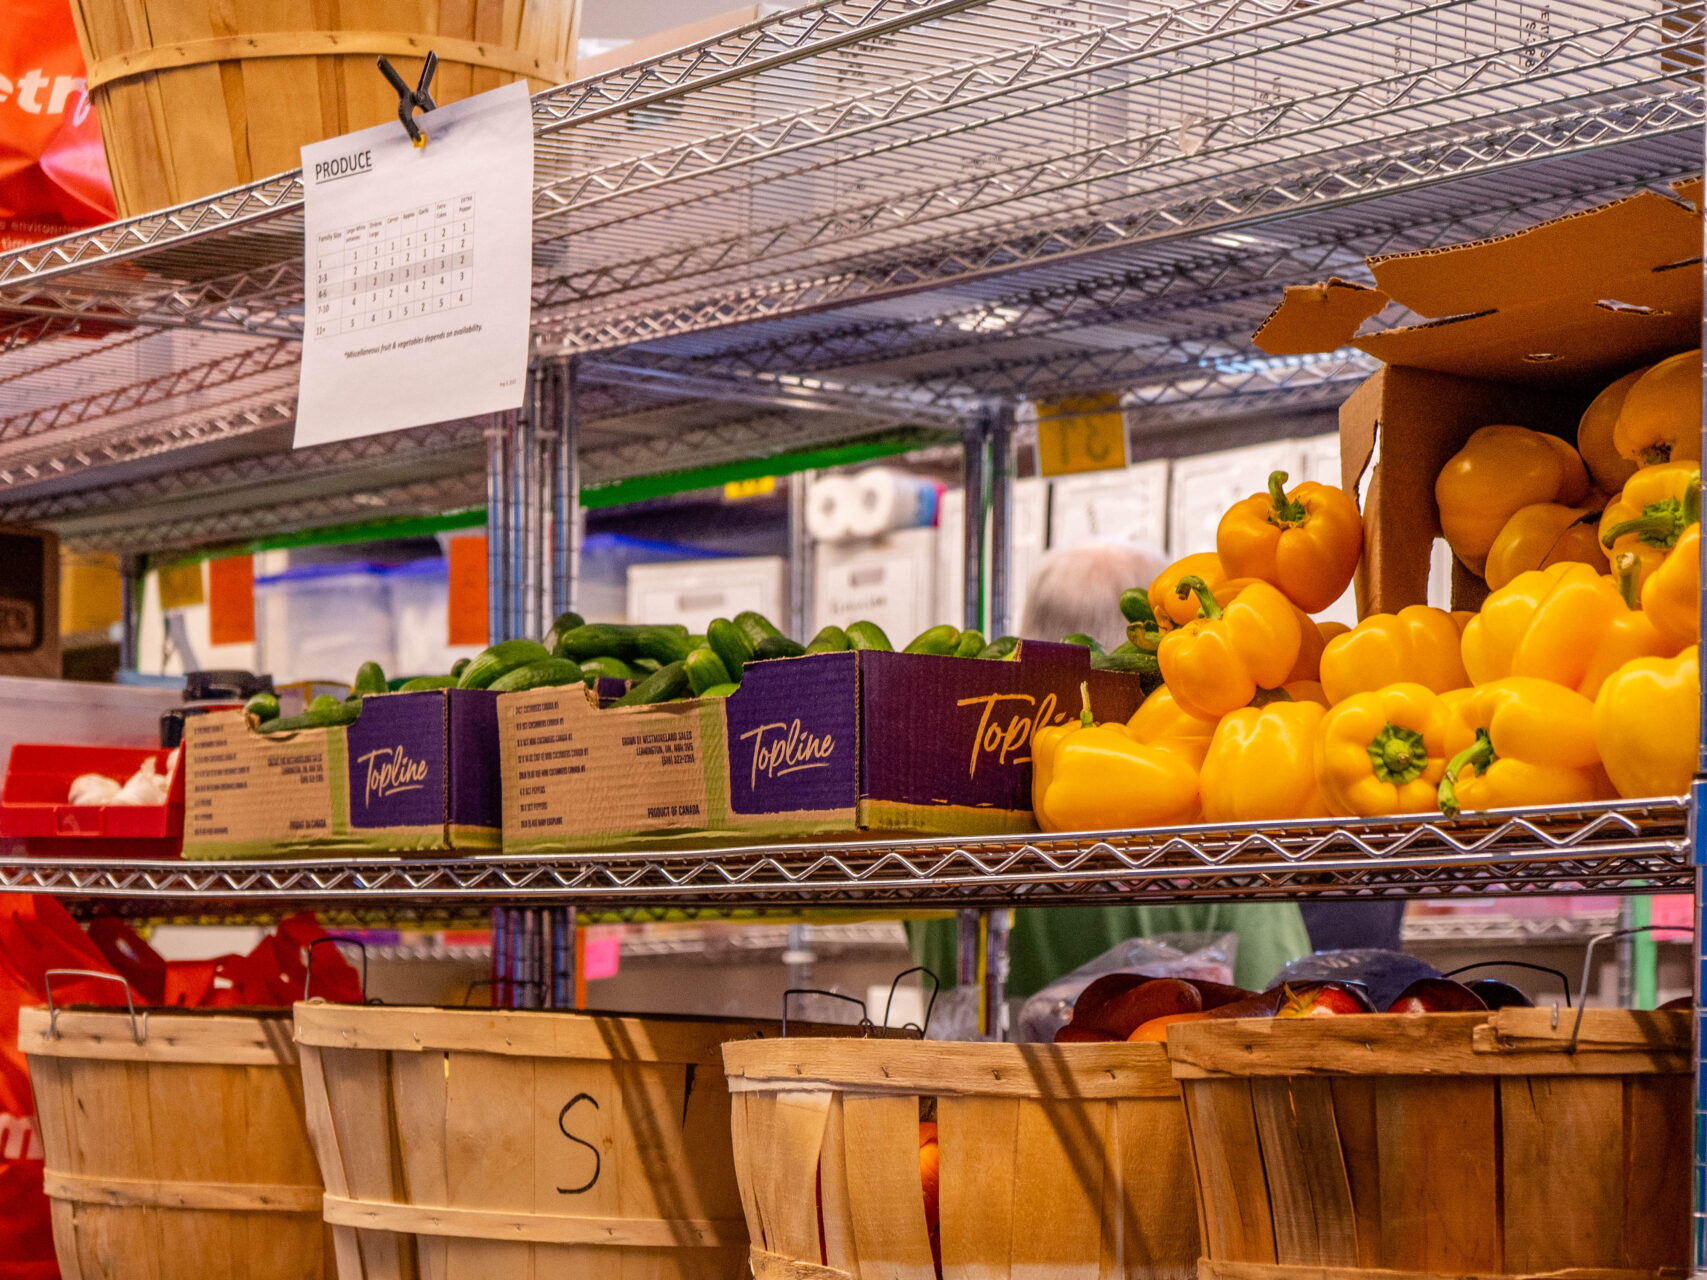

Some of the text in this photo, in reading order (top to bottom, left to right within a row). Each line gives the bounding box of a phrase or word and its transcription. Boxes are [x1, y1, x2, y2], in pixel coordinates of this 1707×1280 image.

[315, 150, 372, 180] PRODUCE
[424, 332, 445, 344] depends
[642, 732, 677, 744] WESTMORELAND
[678, 730, 693, 741] SALES
[740, 718, 835, 792] Topline
[357, 745, 428, 808] Topline
[647, 804, 700, 818] PRODUCT OF CANADA
[557, 1093, 600, 1194] S
